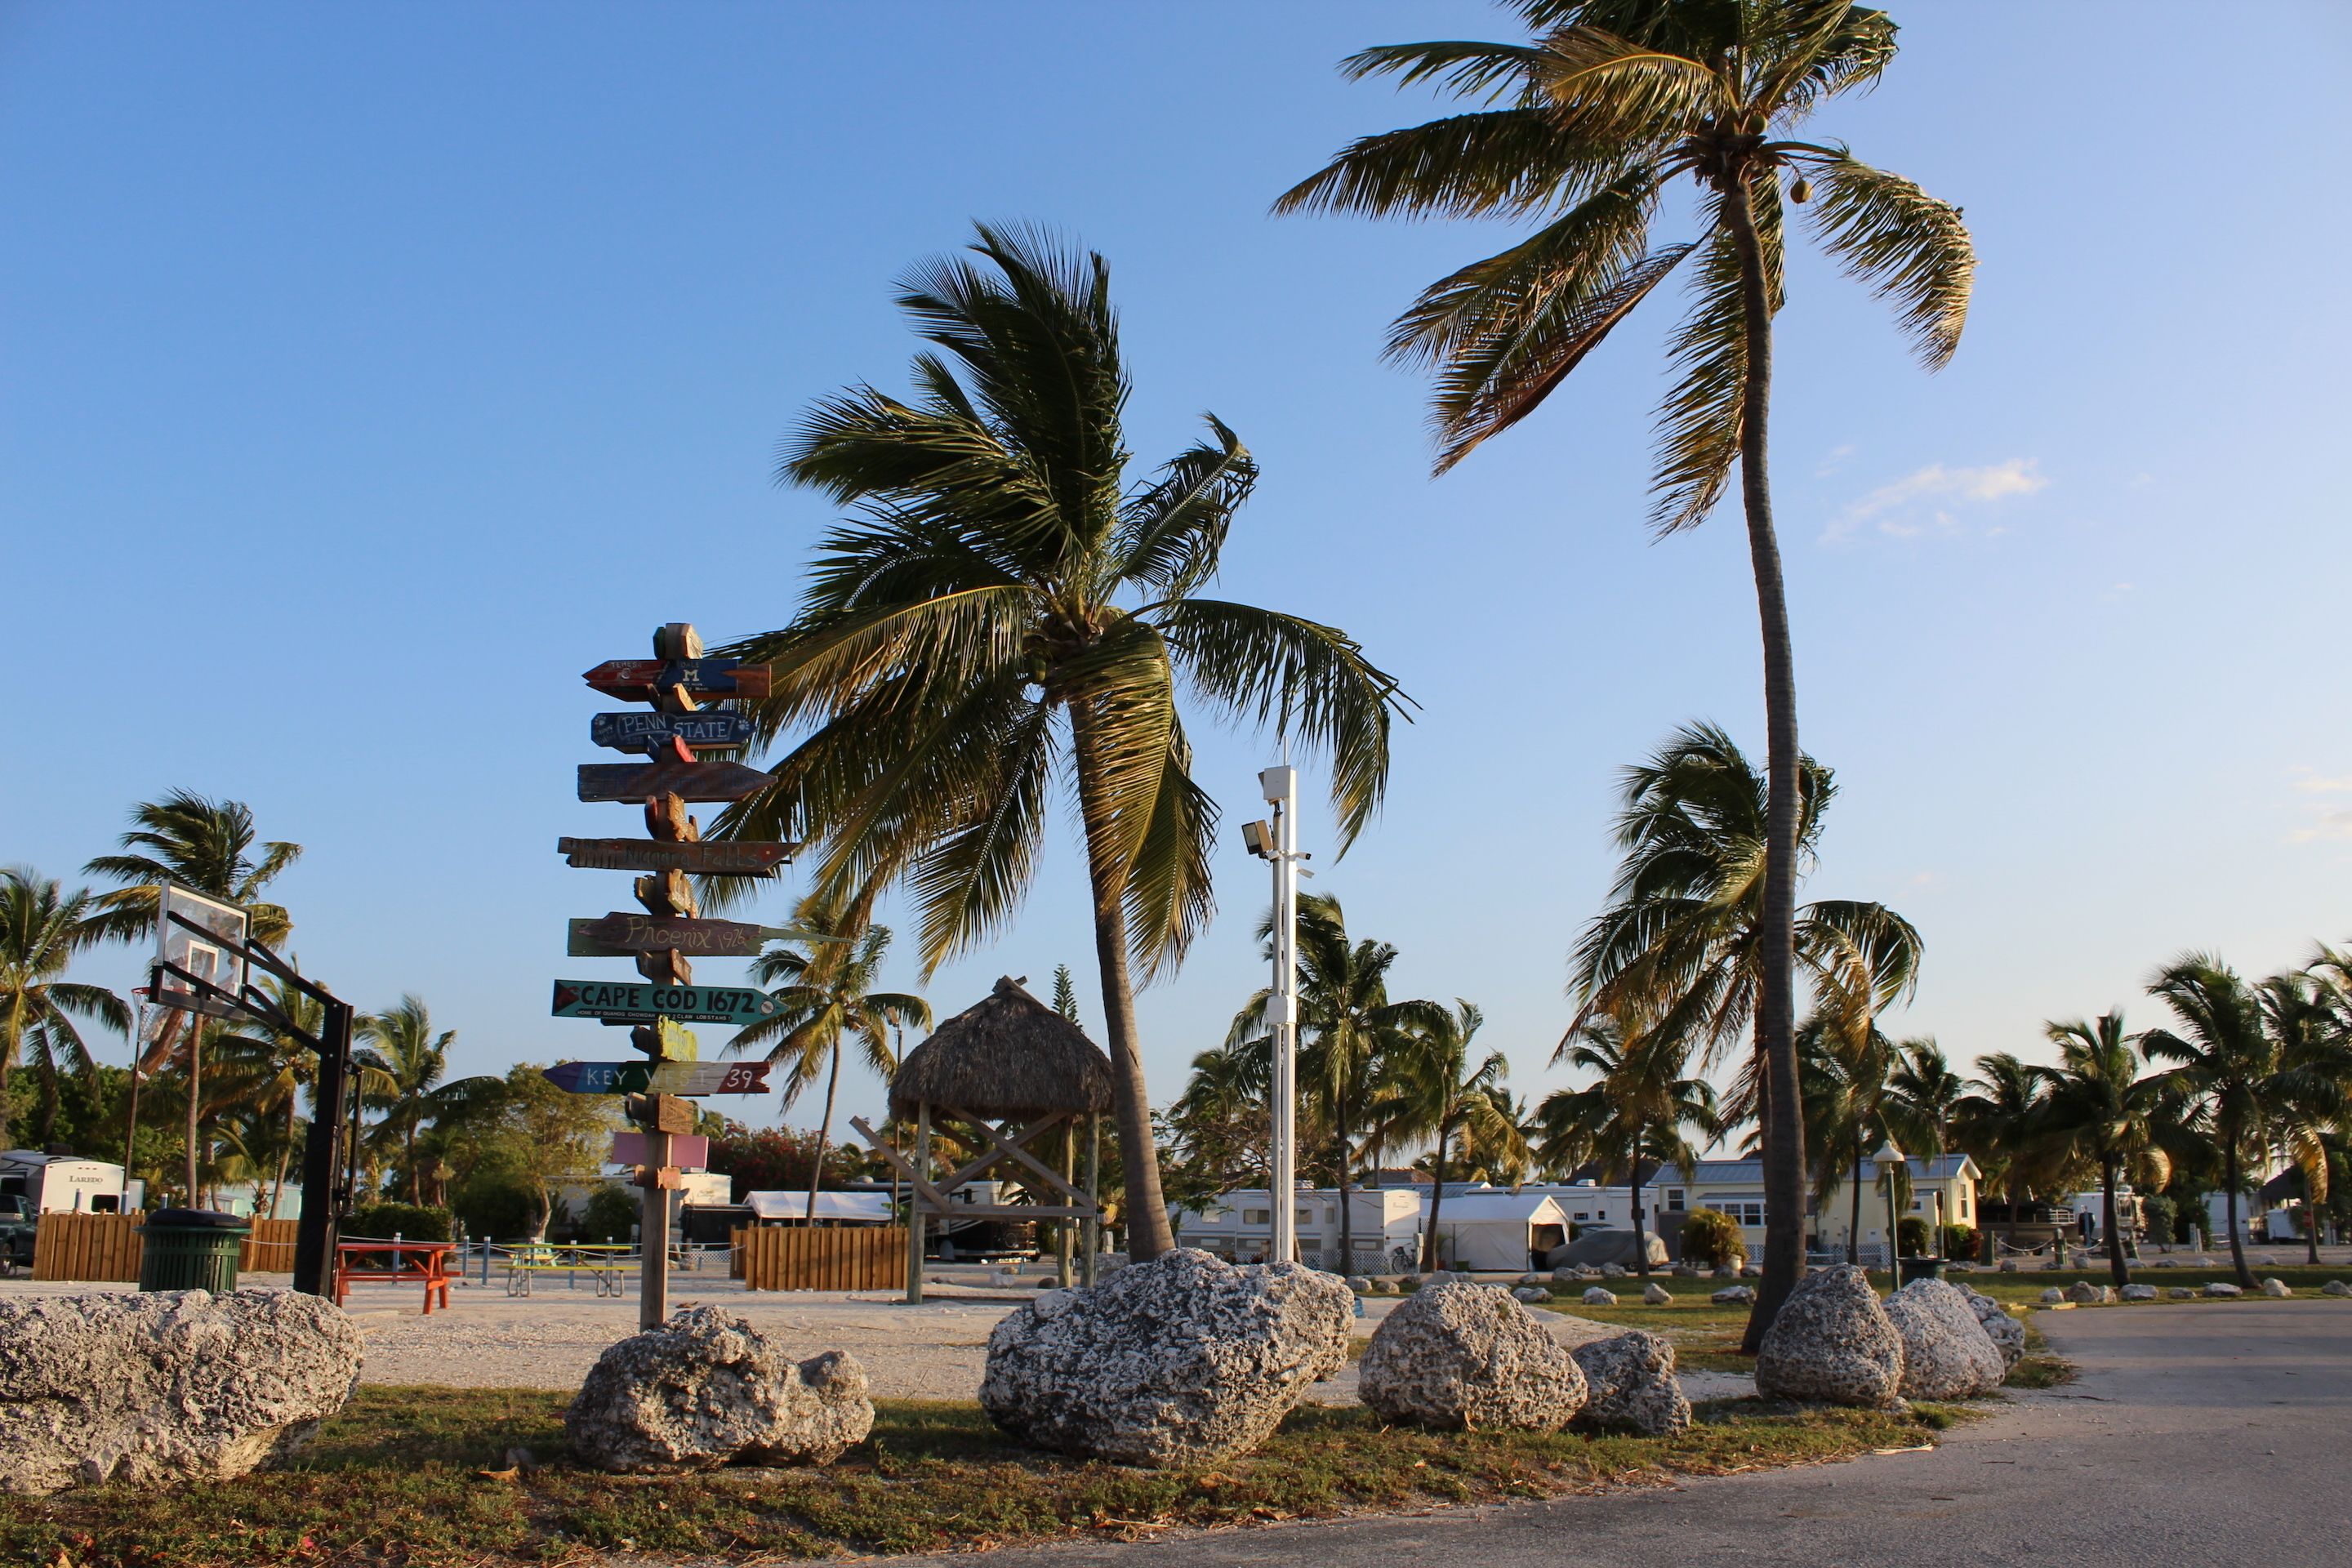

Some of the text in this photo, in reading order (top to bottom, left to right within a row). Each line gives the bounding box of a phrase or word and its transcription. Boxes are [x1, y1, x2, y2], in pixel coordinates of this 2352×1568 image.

[683, 670, 700, 682] M
[622, 715, 666, 733] PENN
[673, 721, 727, 738] STATE
[626, 845, 690, 868] Niagara
[625, 915, 712, 949] Phoenix
[581, 985, 641, 1009] CAPE
[652, 989, 697, 1010] COD
[587, 1068, 753, 1089] KEY WEST 39
